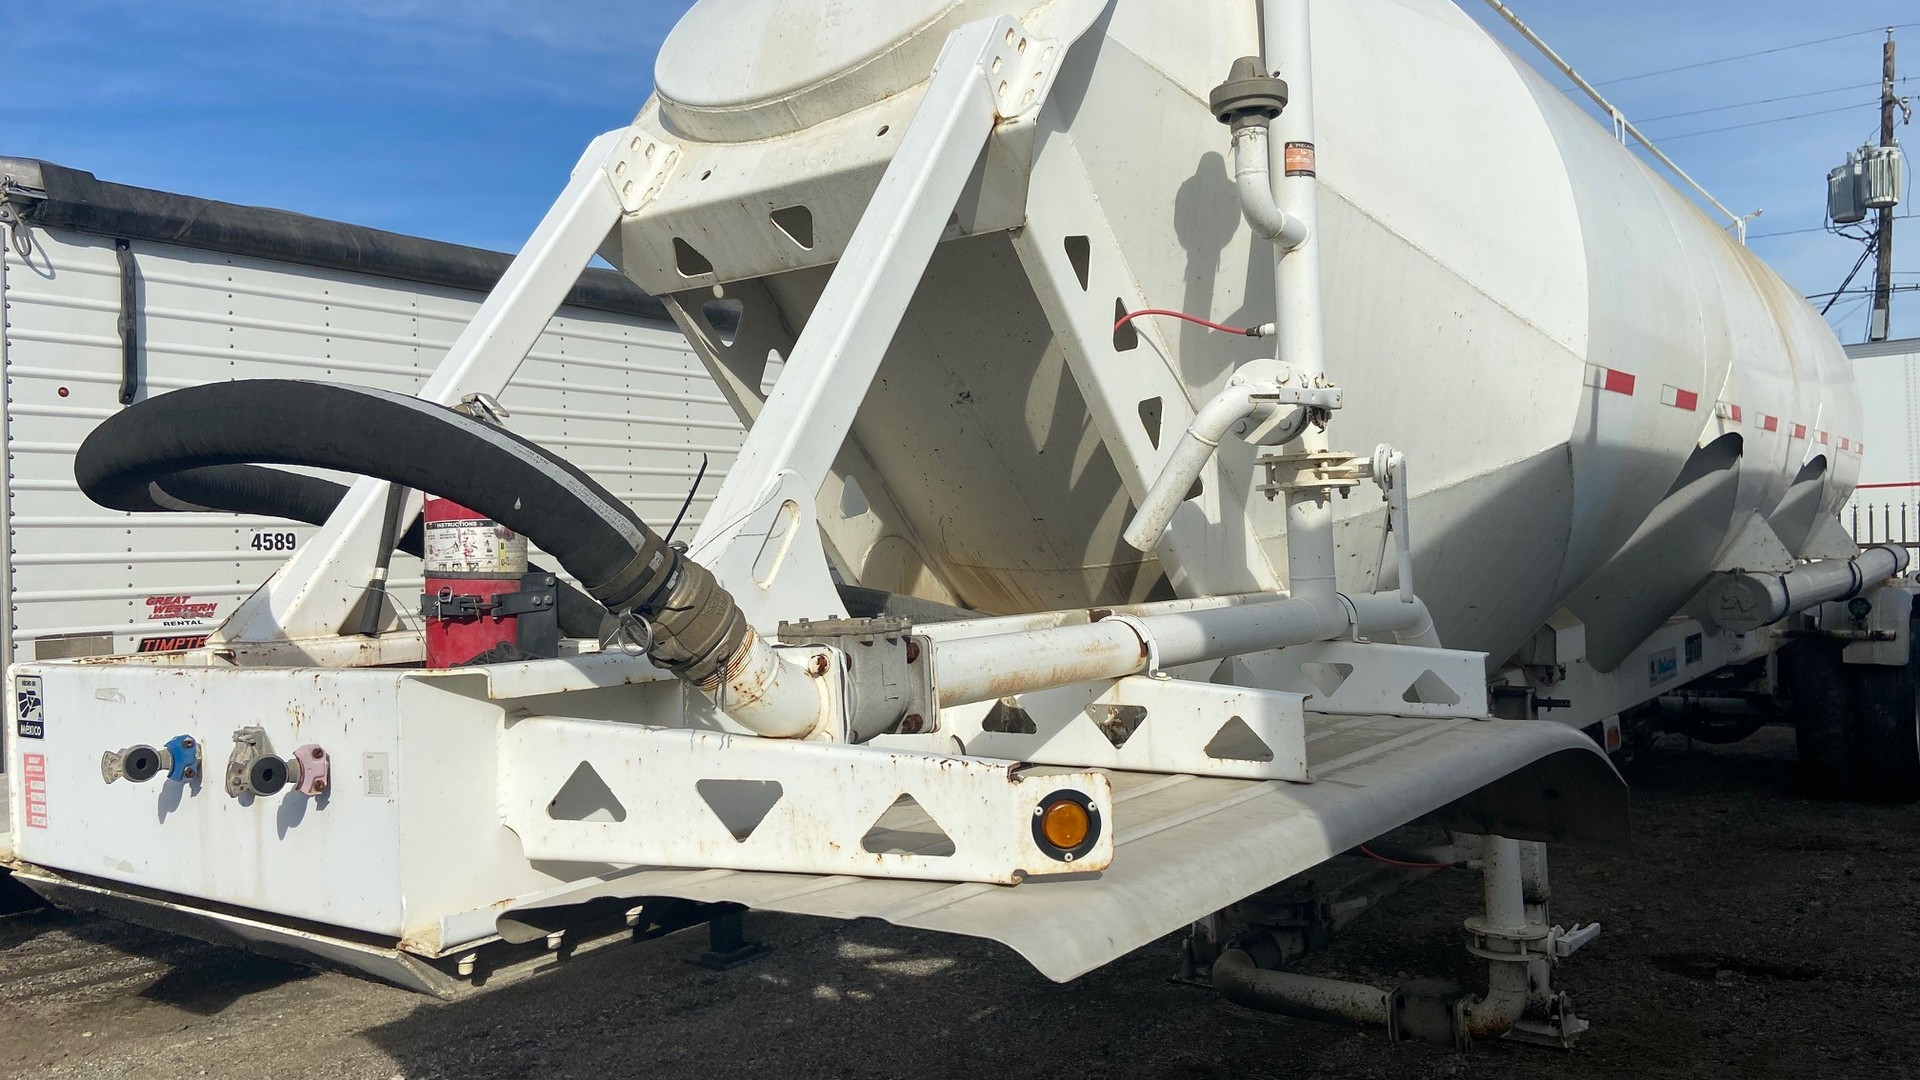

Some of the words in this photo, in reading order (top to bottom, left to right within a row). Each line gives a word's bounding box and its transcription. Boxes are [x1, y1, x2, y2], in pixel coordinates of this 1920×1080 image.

[251, 533, 296, 551] 4589
[146, 596, 191, 606] GREAT
[153, 603, 218, 614] WESTERN
